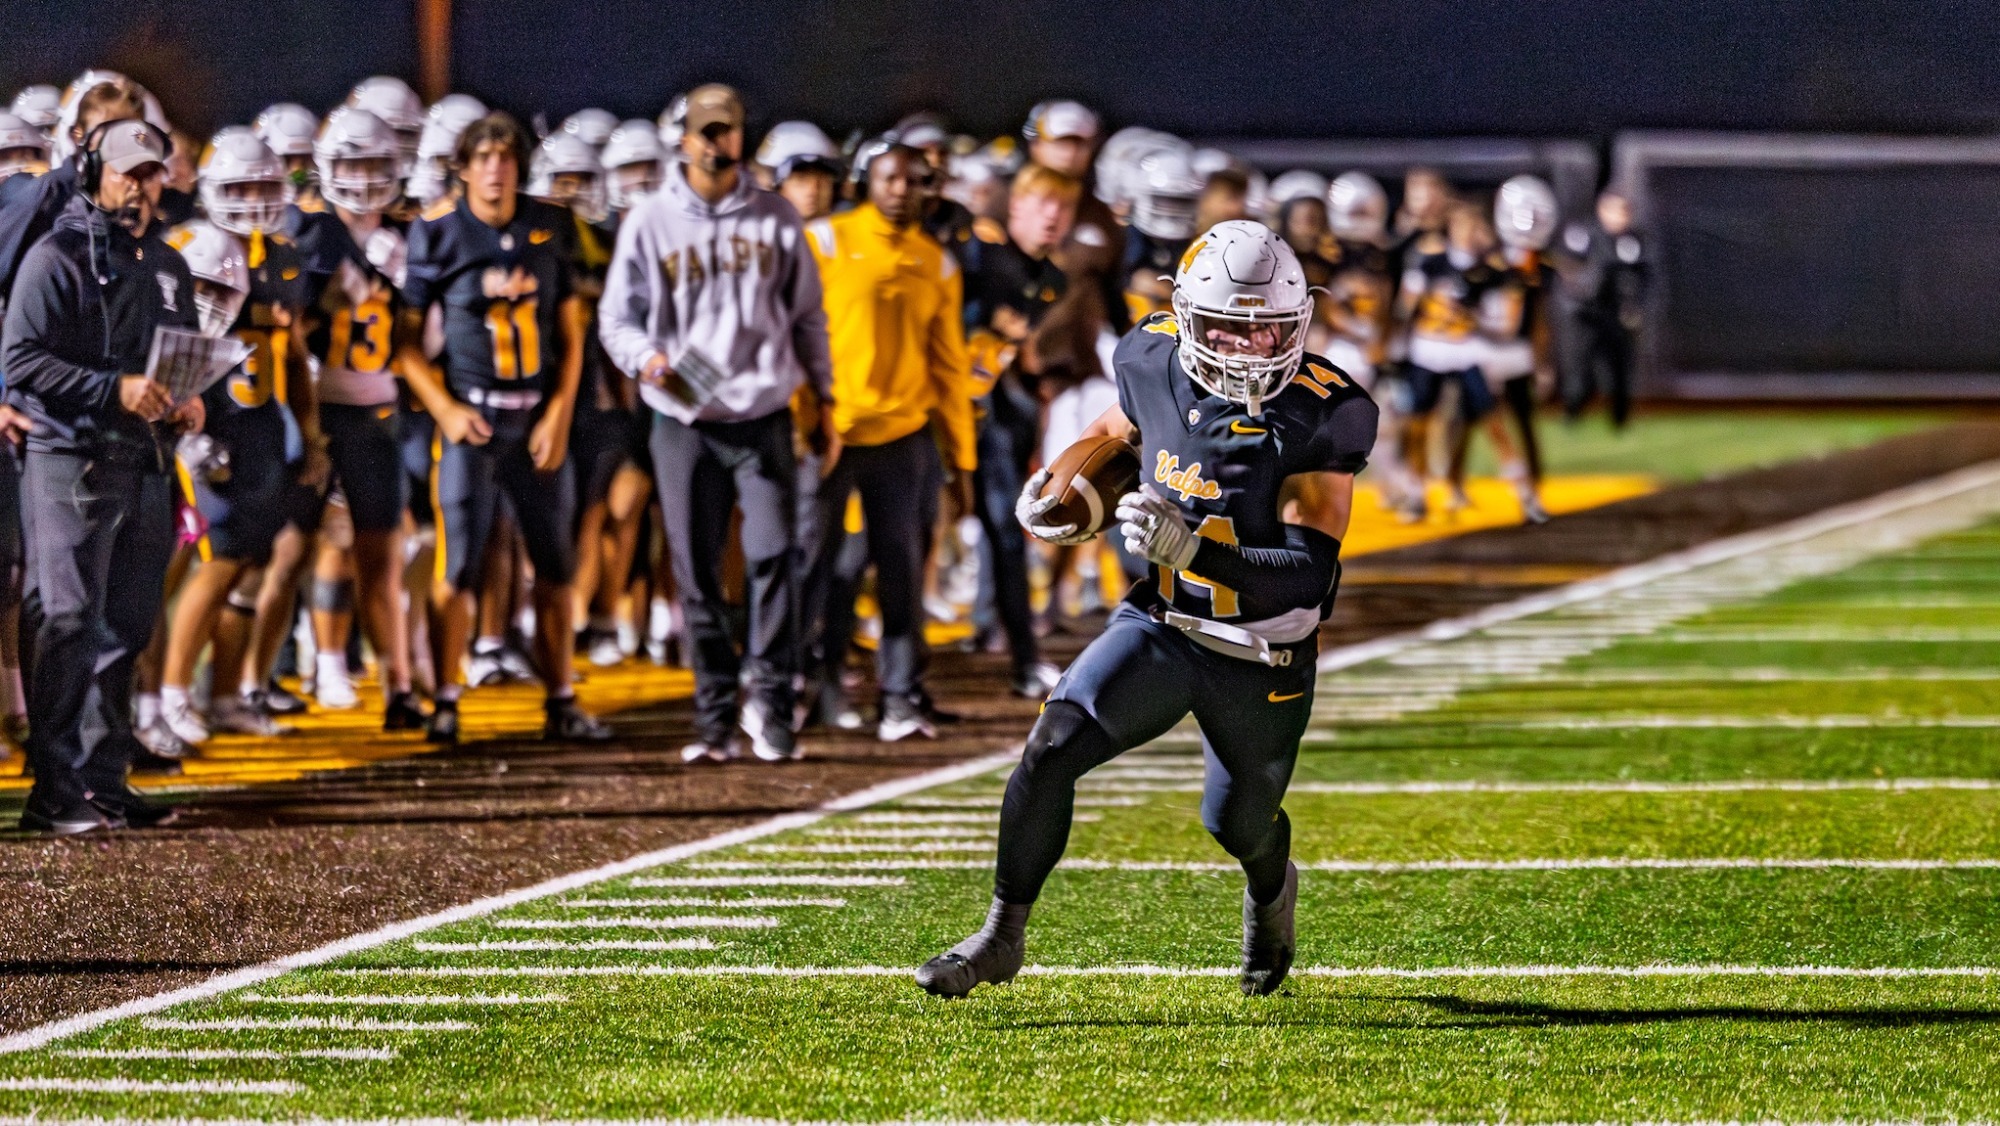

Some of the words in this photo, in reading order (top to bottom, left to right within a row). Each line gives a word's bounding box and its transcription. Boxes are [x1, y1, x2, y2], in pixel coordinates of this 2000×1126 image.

[659, 232, 775, 292] VALPO
[327, 301, 394, 373] 13
[484, 301, 542, 381] 11
[1291, 362, 1350, 400] 14
[1154, 448, 1223, 502] Valpo
